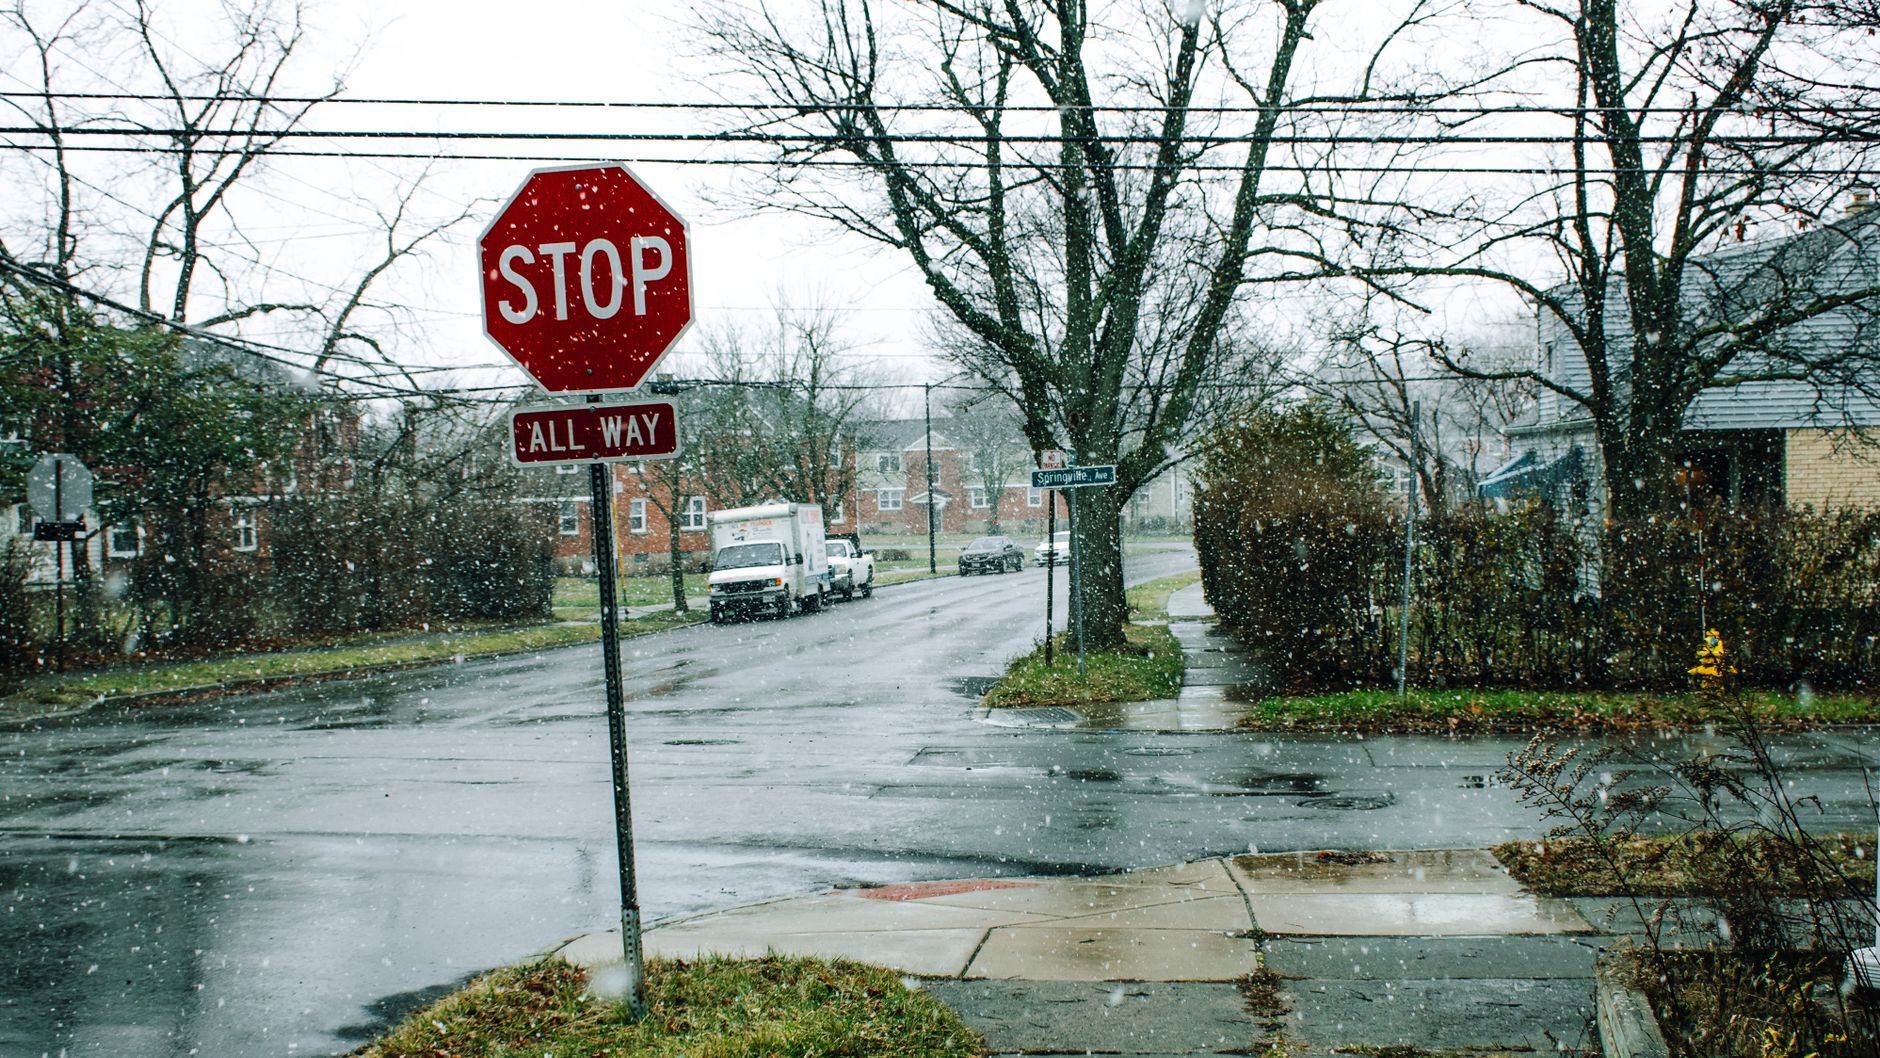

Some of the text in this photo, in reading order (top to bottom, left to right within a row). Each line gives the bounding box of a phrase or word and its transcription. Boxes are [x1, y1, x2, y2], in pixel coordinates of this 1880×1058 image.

[498, 236, 673, 325] STOP
[529, 413, 660, 453] ALL WAY
[1037, 471, 1108, 485] Springville Ave
